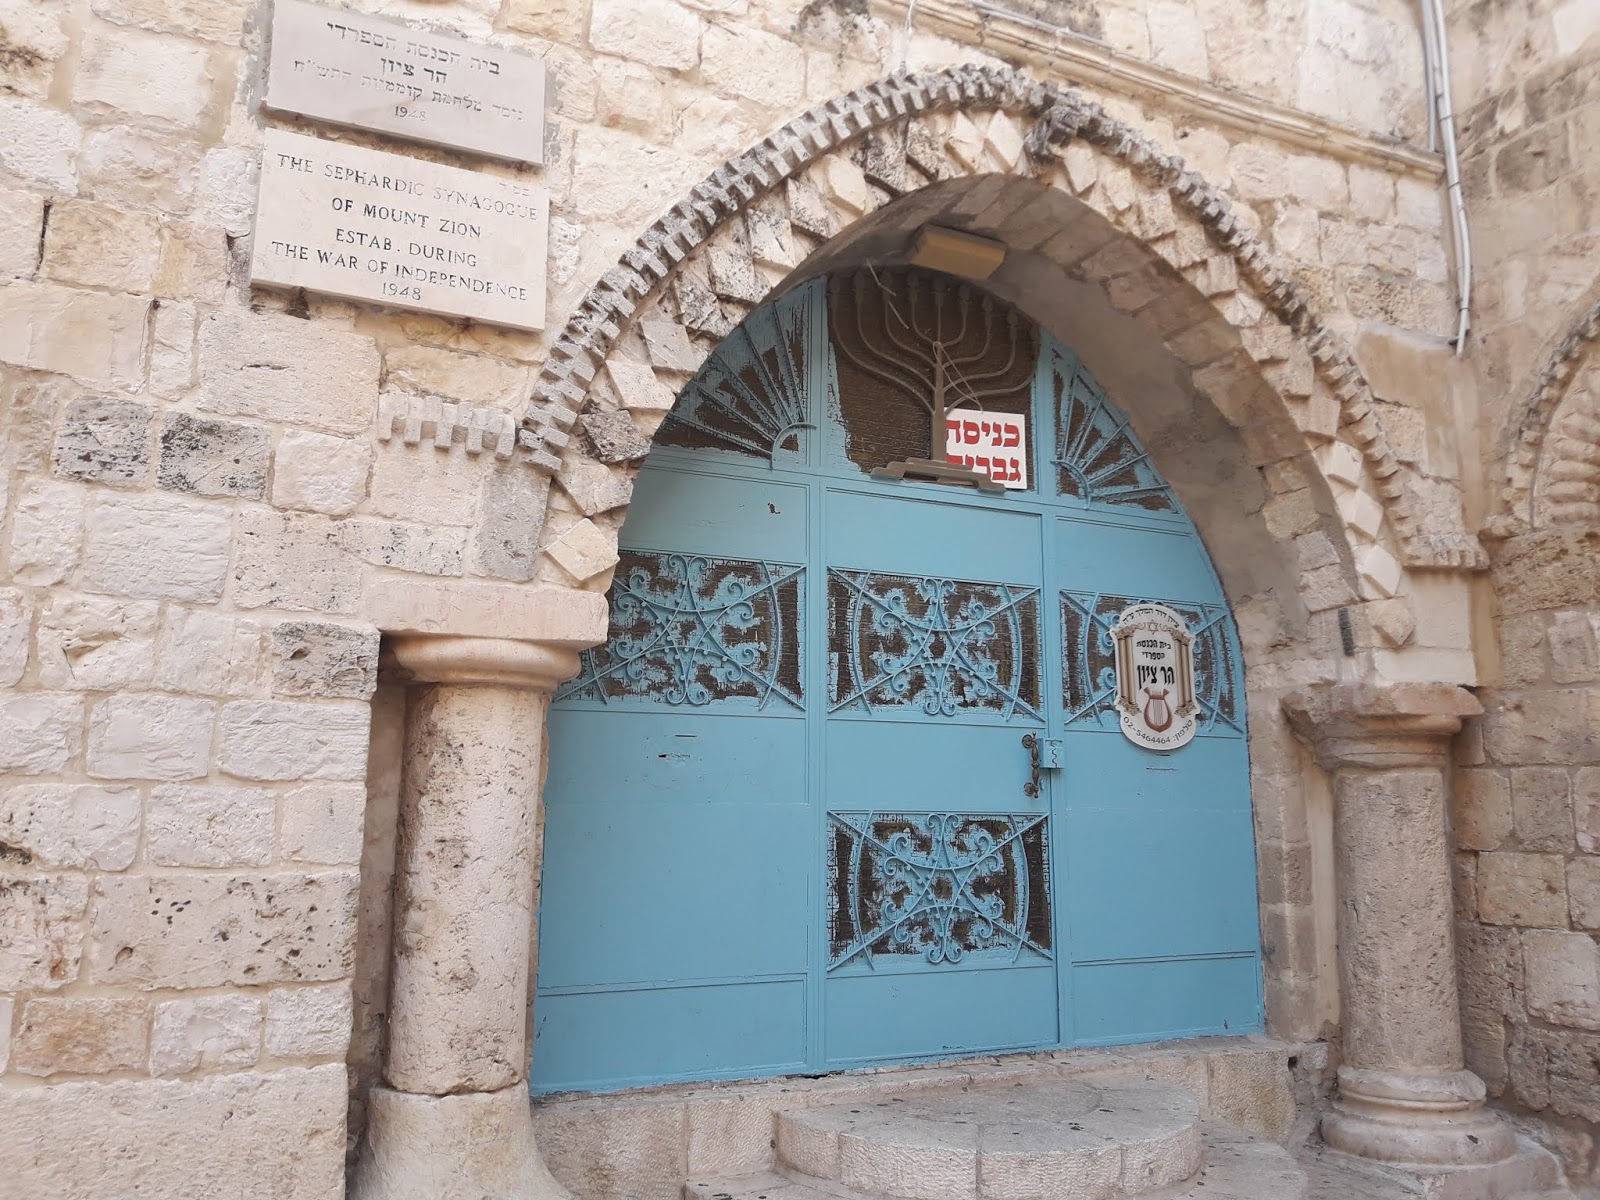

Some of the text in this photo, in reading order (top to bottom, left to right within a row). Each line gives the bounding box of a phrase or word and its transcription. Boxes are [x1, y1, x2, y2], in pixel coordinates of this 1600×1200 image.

[327, 22, 500, 75] בית הכנסת הספרדי
[381, 58, 447, 84] הר ציון
[395, 106, 427, 121] 1948
[431, 91, 482, 112] מלחמת
[277, 153, 538, 221] THE SEPHARDIC SYNAGOGUE
[332, 197, 482, 239] OF MOUNT ZION
[409, 242, 477, 268] DURING
[271, 241, 527, 301] THE WAR OF INDEPENDENCE
[382, 282, 421, 301] 1948
[1136, 639, 1171, 650] בית הכנסת
[1141, 651, 1166, 660] הספרדי
[1137, 664, 1175, 691] הר ציון
[1123, 716, 1171, 744] 02-5464464
